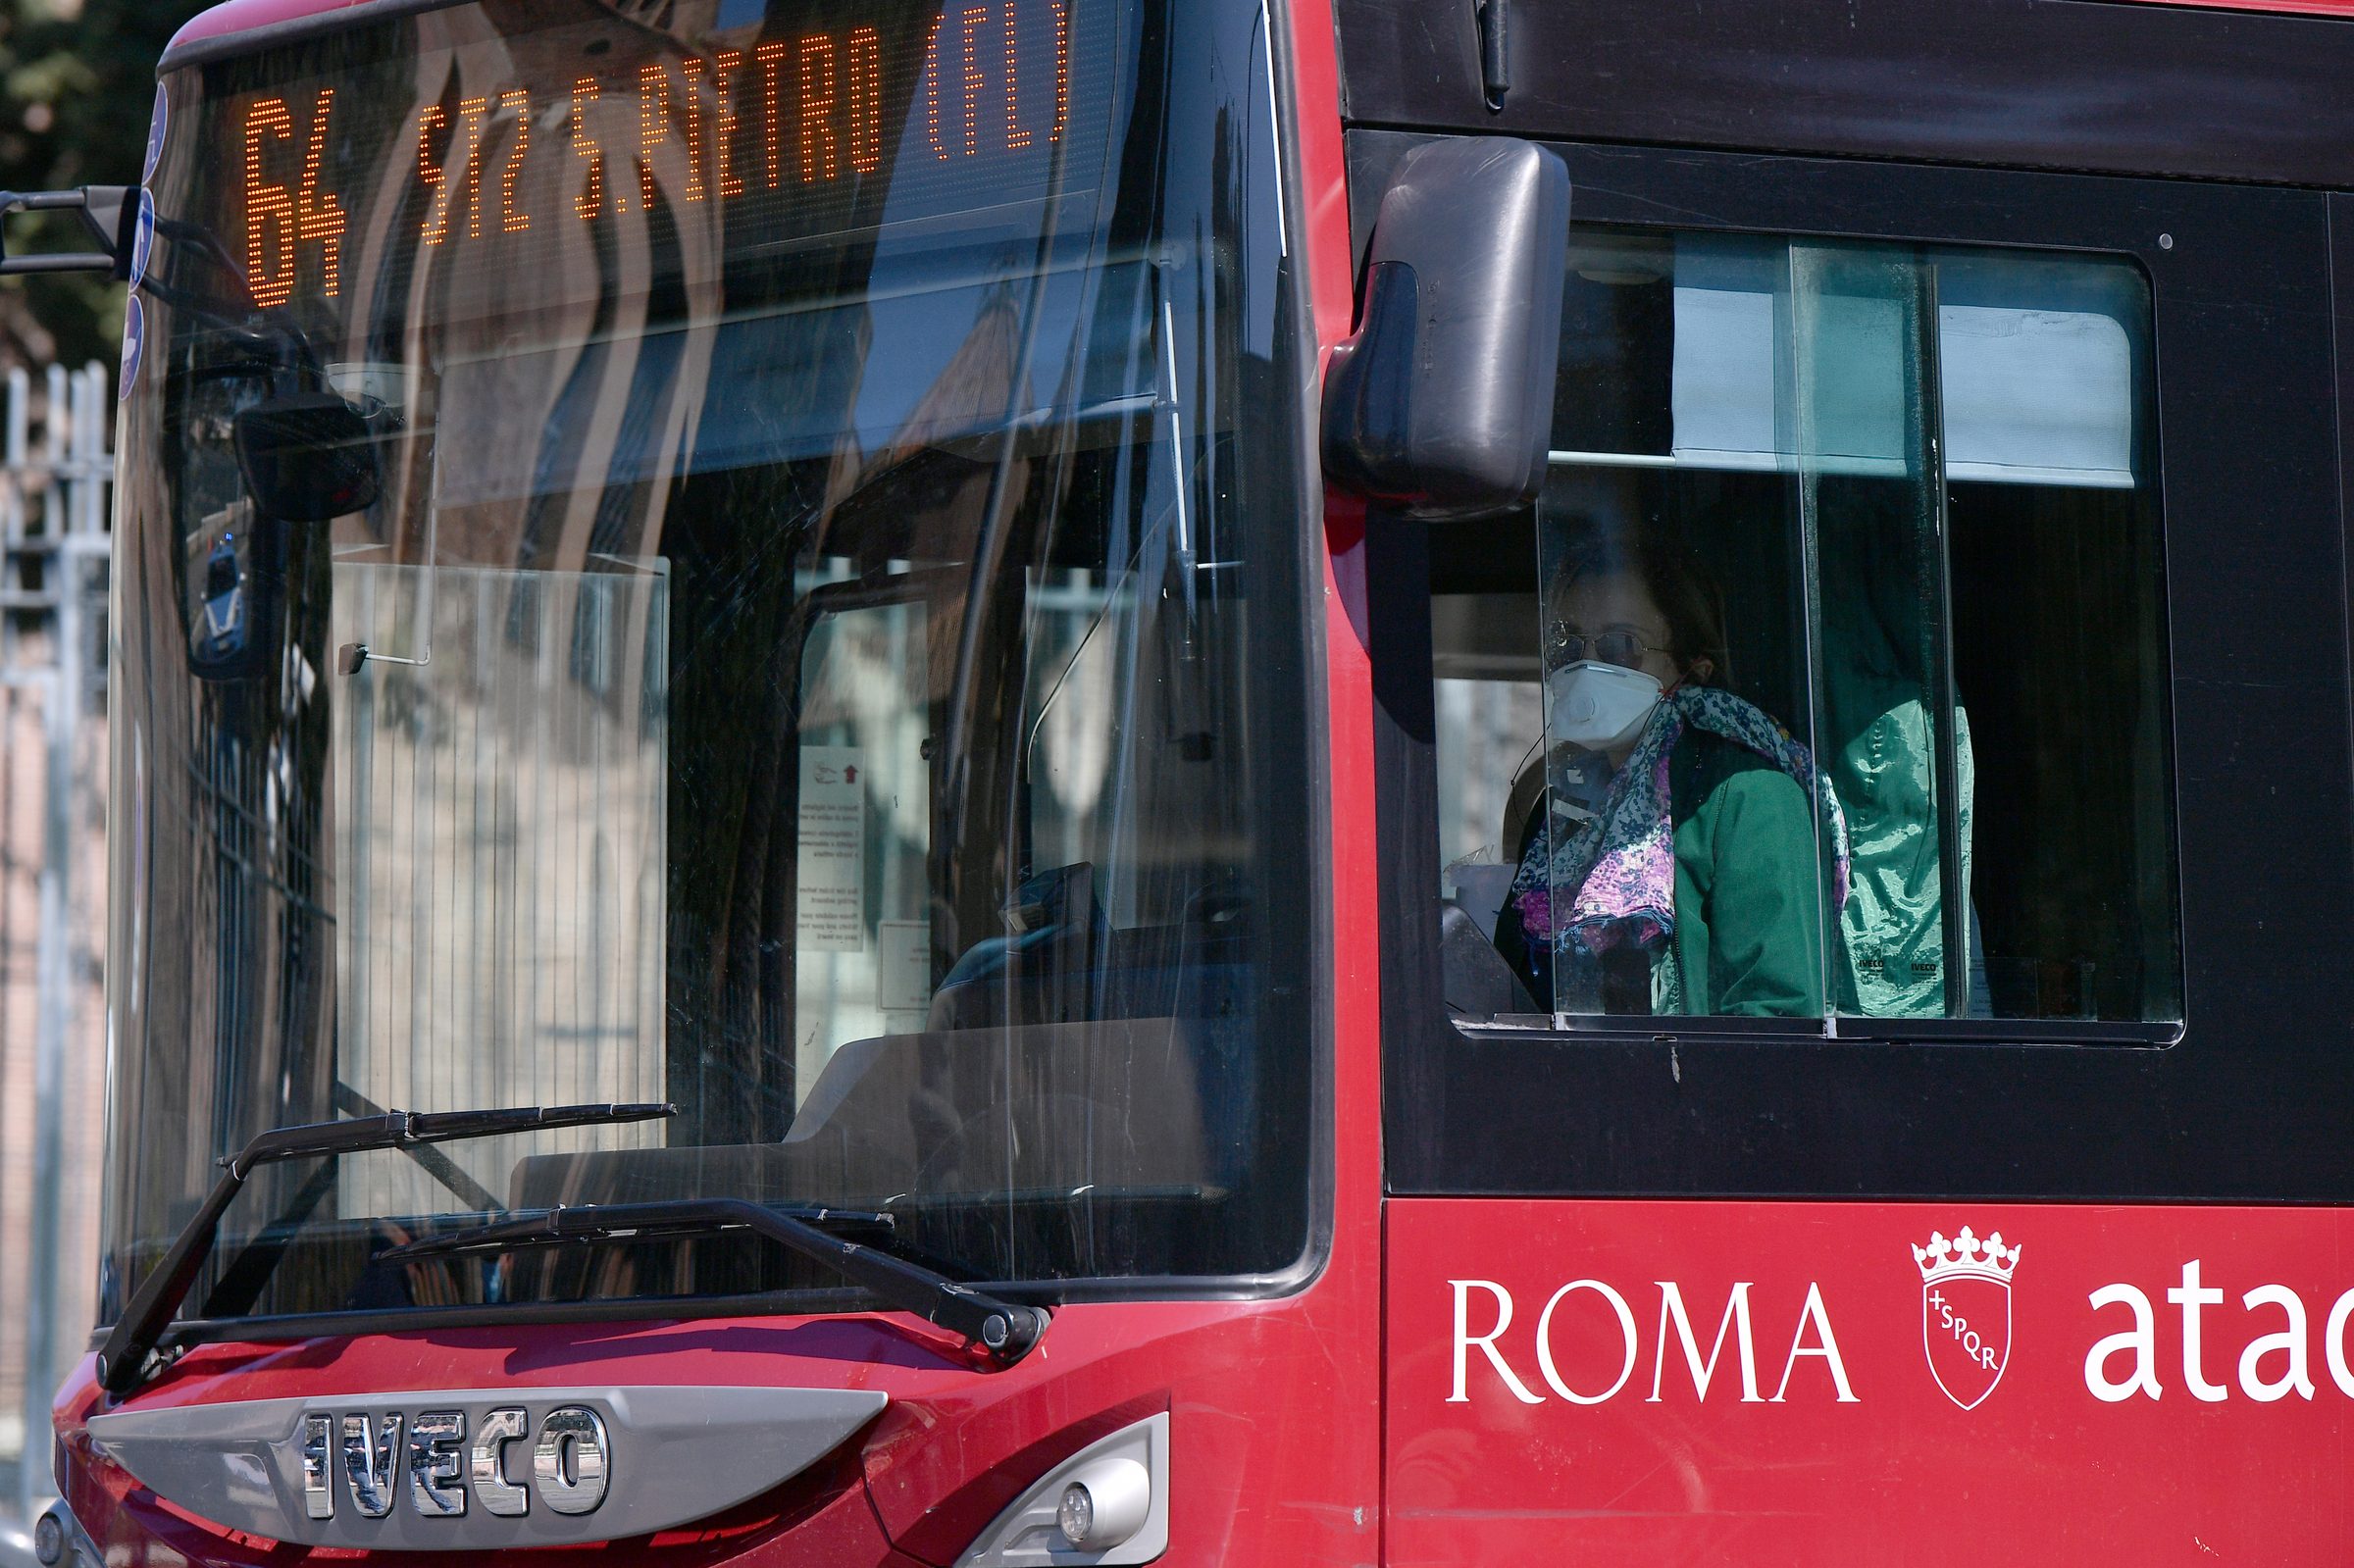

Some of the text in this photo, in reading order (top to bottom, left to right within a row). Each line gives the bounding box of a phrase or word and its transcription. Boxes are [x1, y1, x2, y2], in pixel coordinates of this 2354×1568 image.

[244, 88, 346, 308] 64
[926, 2, 1068, 161] (FL)
[1859, 959, 1884, 968] IVECO
[1911, 963, 1936, 972] IVECO
[1445, 1279, 1862, 1404] ROMA
[303, 1404, 611, 1521] IVECO
